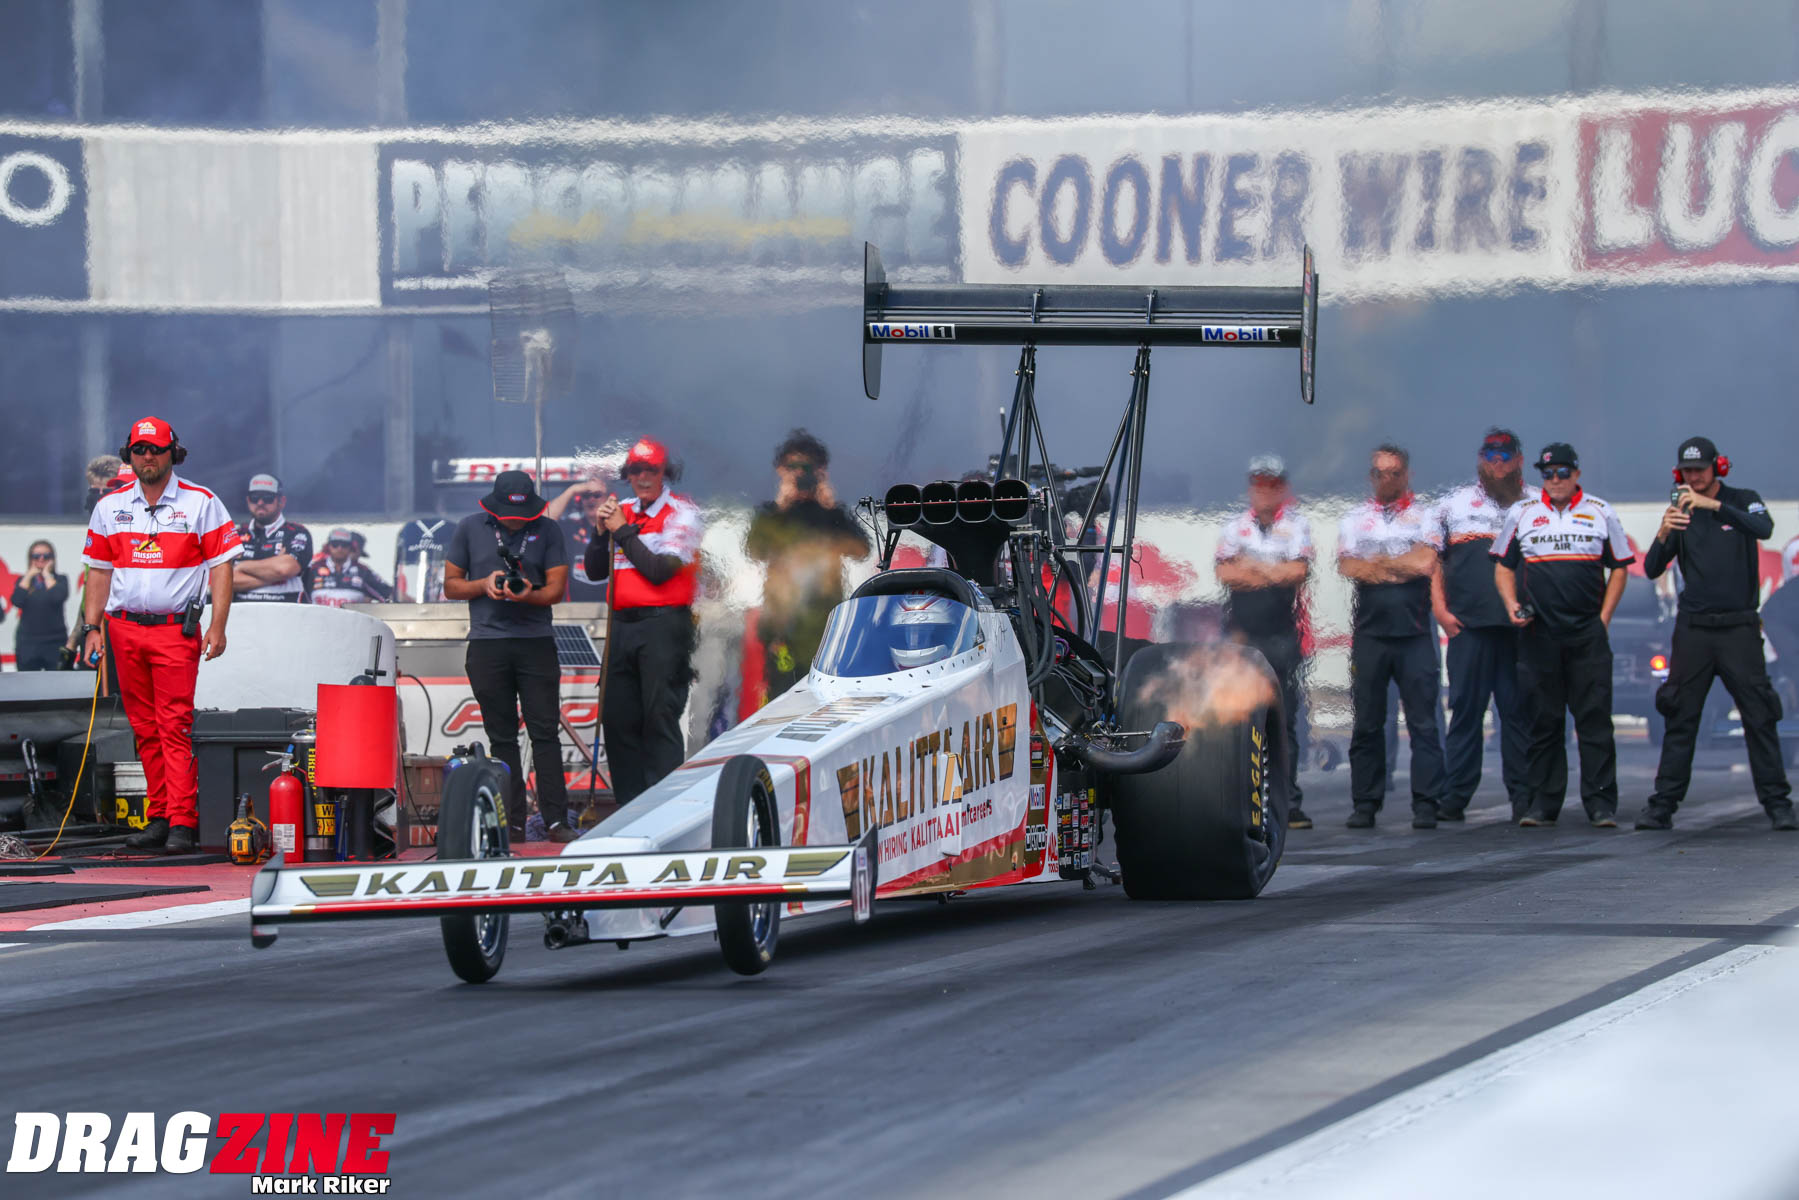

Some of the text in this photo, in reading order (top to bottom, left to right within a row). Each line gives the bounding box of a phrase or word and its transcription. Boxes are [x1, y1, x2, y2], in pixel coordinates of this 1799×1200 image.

[1591, 112, 1799, 252] LUC
[989, 149, 1311, 268] COONER
[1337, 140, 1549, 262] WIRE
[871, 324, 946, 338] Mobil 1
[1204, 327, 1264, 341] Mobil
[1539, 534, 1585, 543] KALITTA
[1553, 543, 1571, 551] AIR
[133, 551, 161, 559] mission
[862, 728, 963, 833] KALITTA
[962, 711, 996, 796] AIR
[1251, 725, 1263, 827] EAGLE
[884, 831, 908, 862] HIRING
[364, 855, 768, 896] KALITTA AIR
